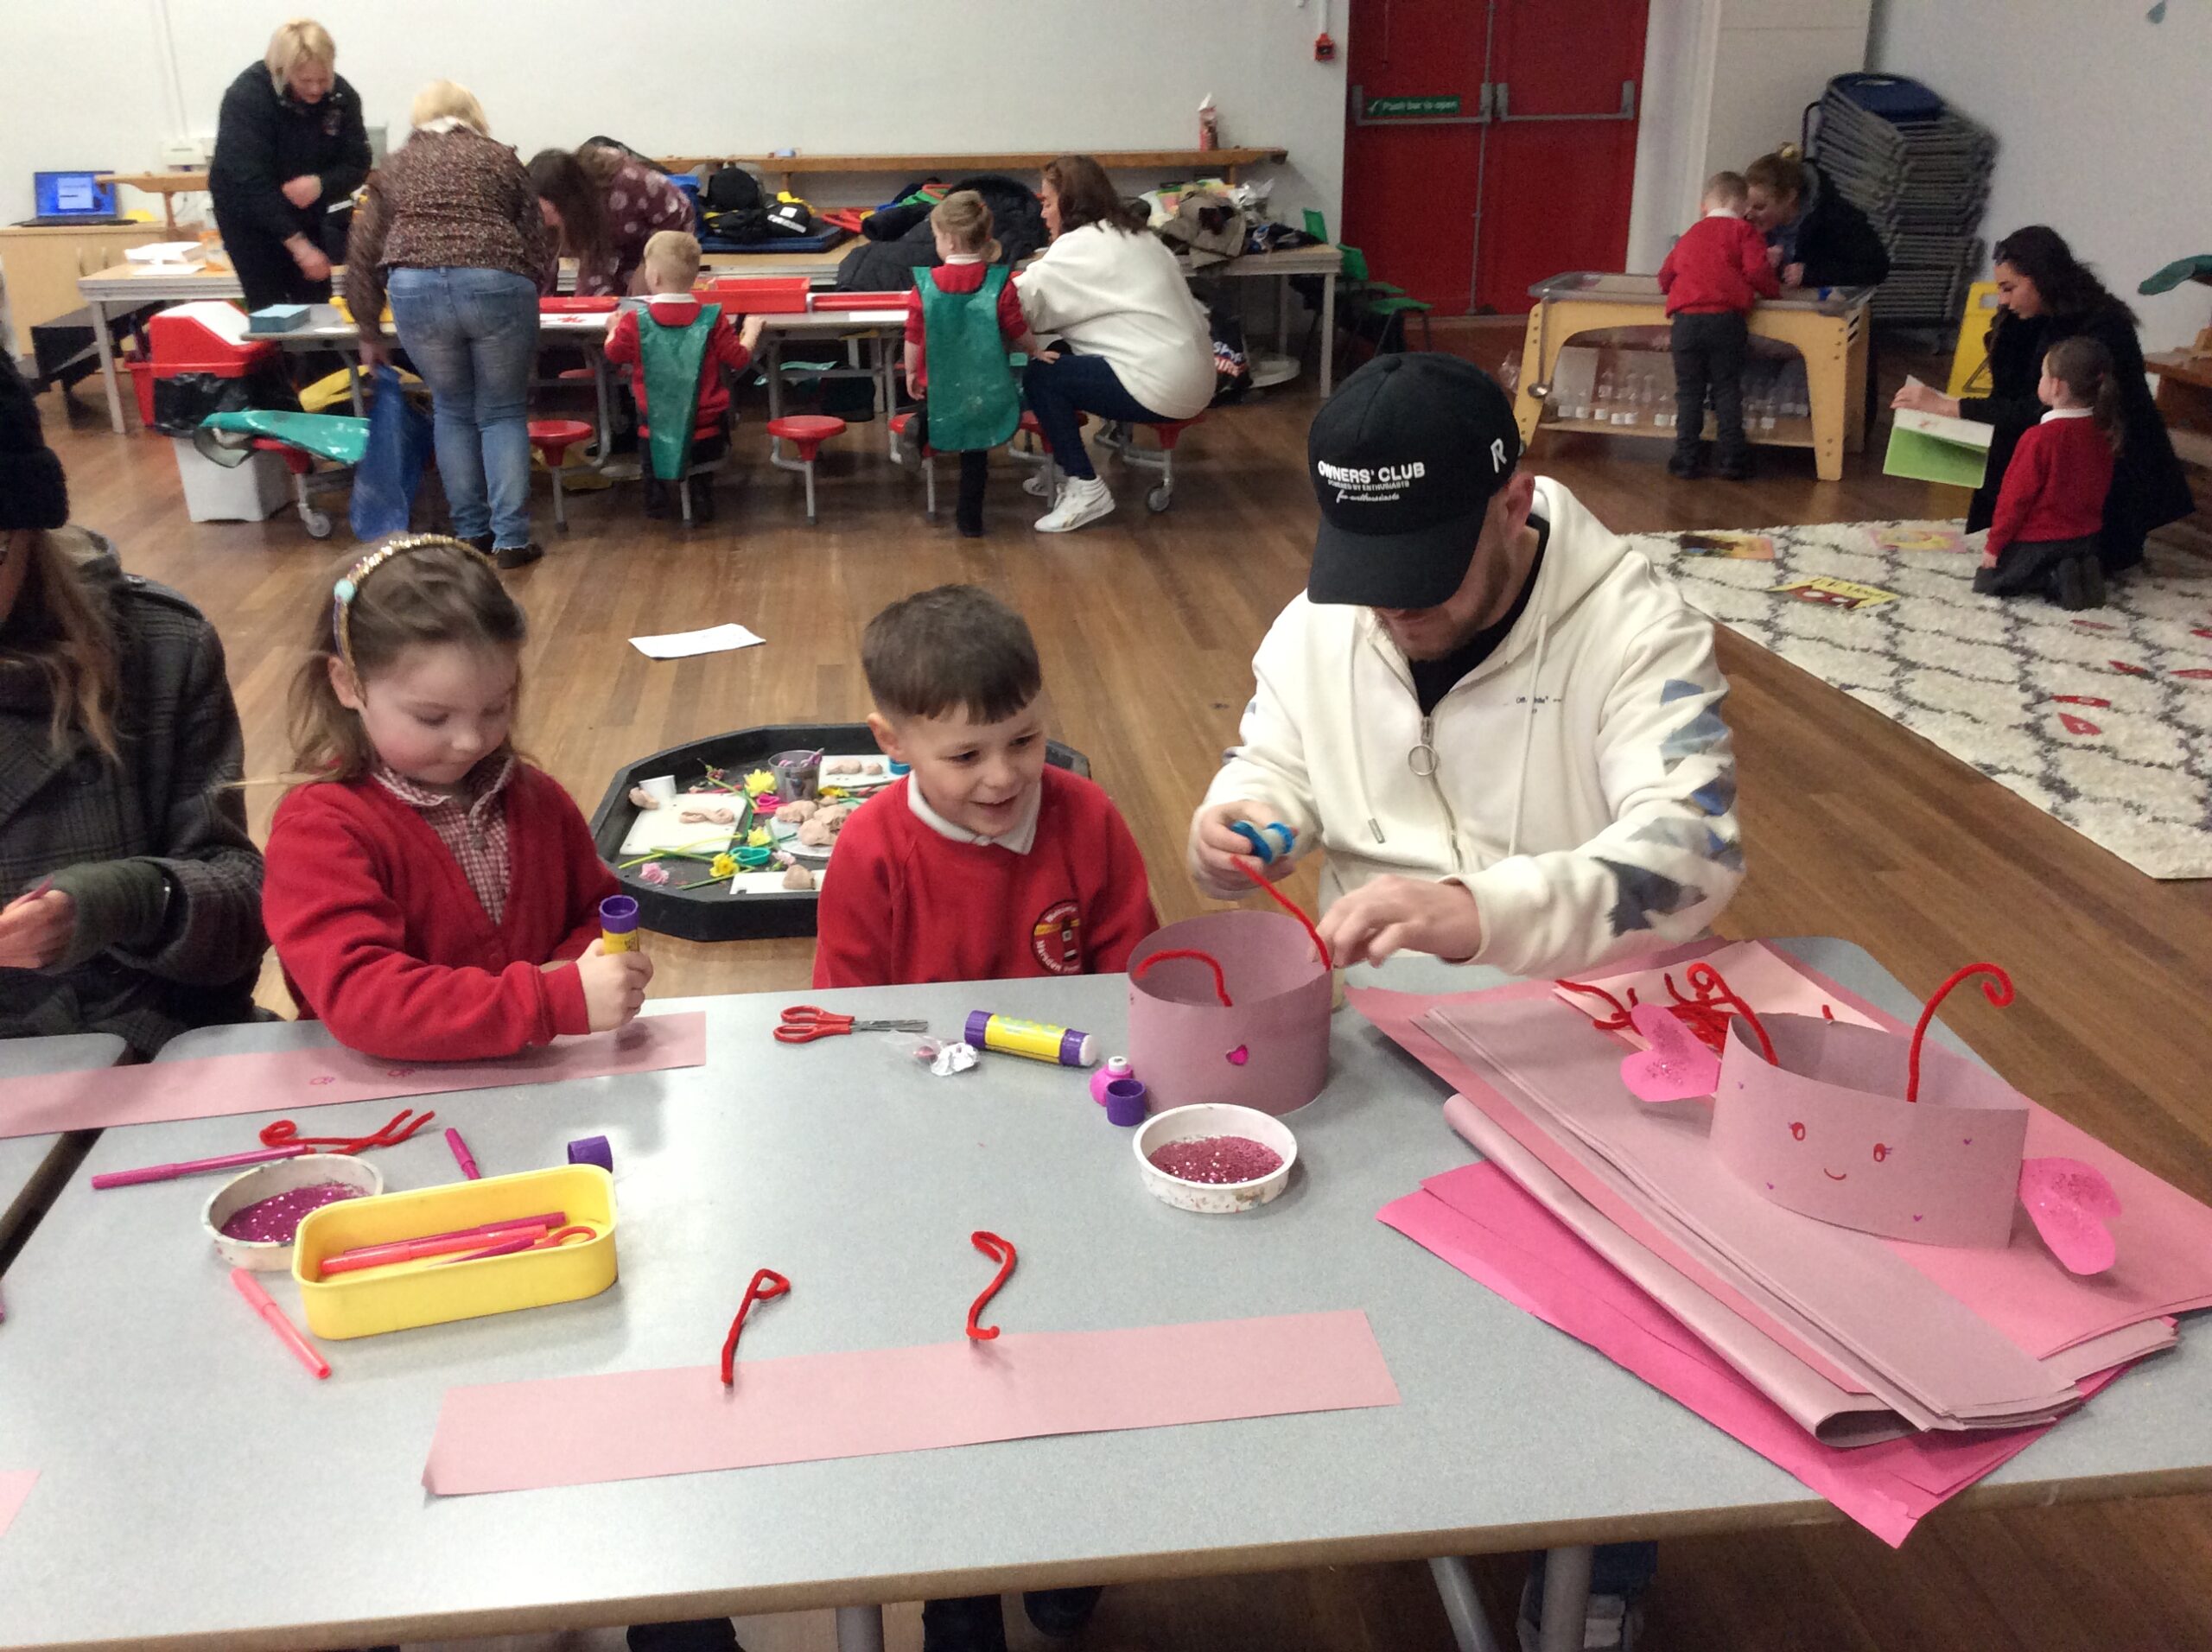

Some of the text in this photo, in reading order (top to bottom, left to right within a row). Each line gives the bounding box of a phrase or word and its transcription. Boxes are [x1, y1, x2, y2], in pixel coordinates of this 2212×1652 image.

[1491, 438, 1507, 473] R
[1318, 461, 1426, 484] OWNERS' CLUB
